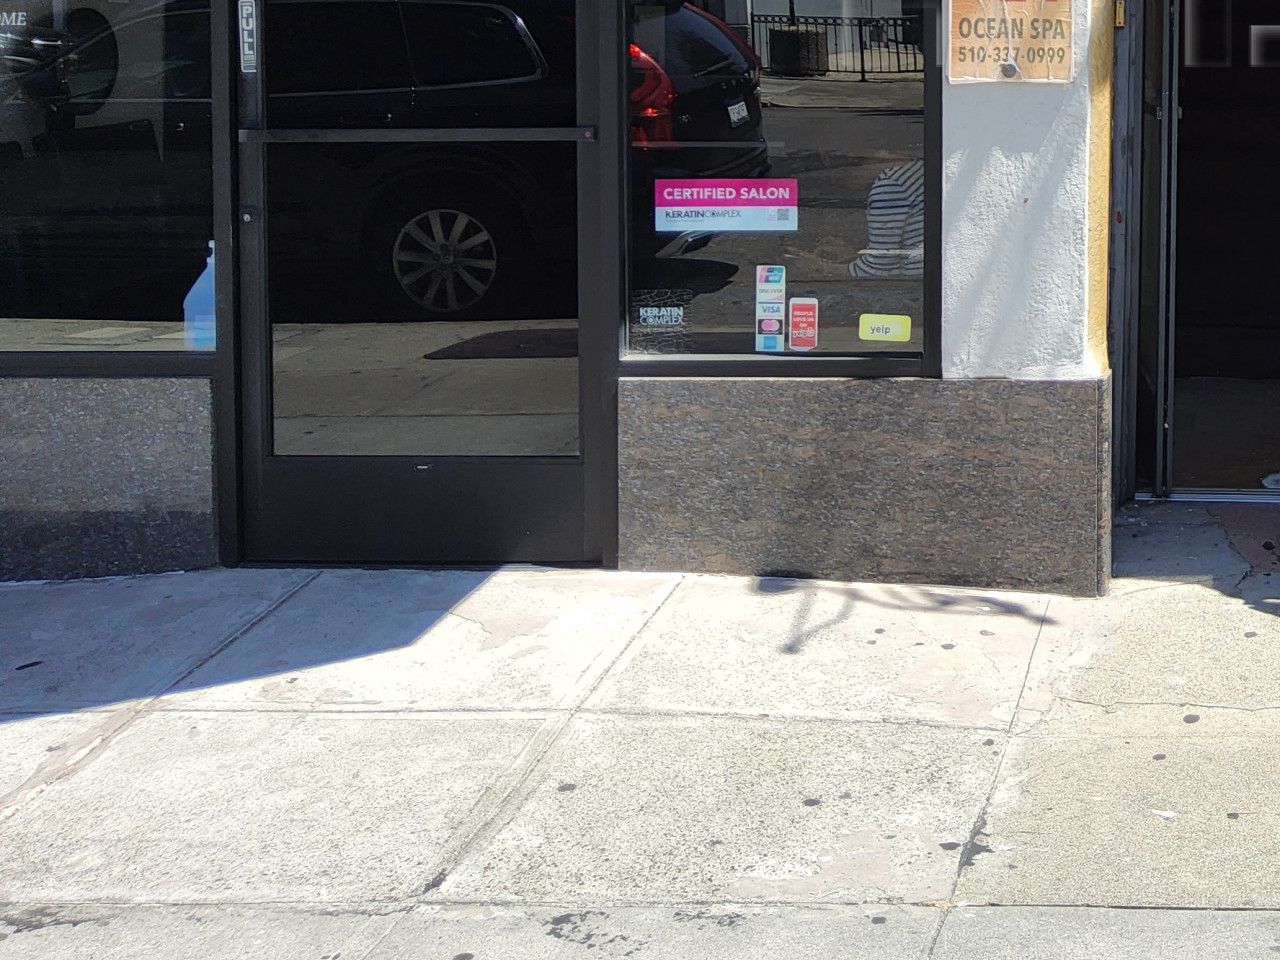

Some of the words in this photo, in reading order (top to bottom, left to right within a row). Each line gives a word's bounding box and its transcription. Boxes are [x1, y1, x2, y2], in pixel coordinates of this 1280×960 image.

[0, 11, 27, 26] ME
[242, 5, 254, 55] PULL
[958, 17, 1024, 39] OCEAN
[1030, 18, 1066, 39] SPA
[958, 46, 1066, 64] 510-337-0999
[663, 187, 737, 200] CERTIFIED
[740, 187, 790, 200] SALON
[640, 306, 684, 316] KERATIN
[762, 306, 781, 314] VISA
[870, 325, 891, 335] yelp
